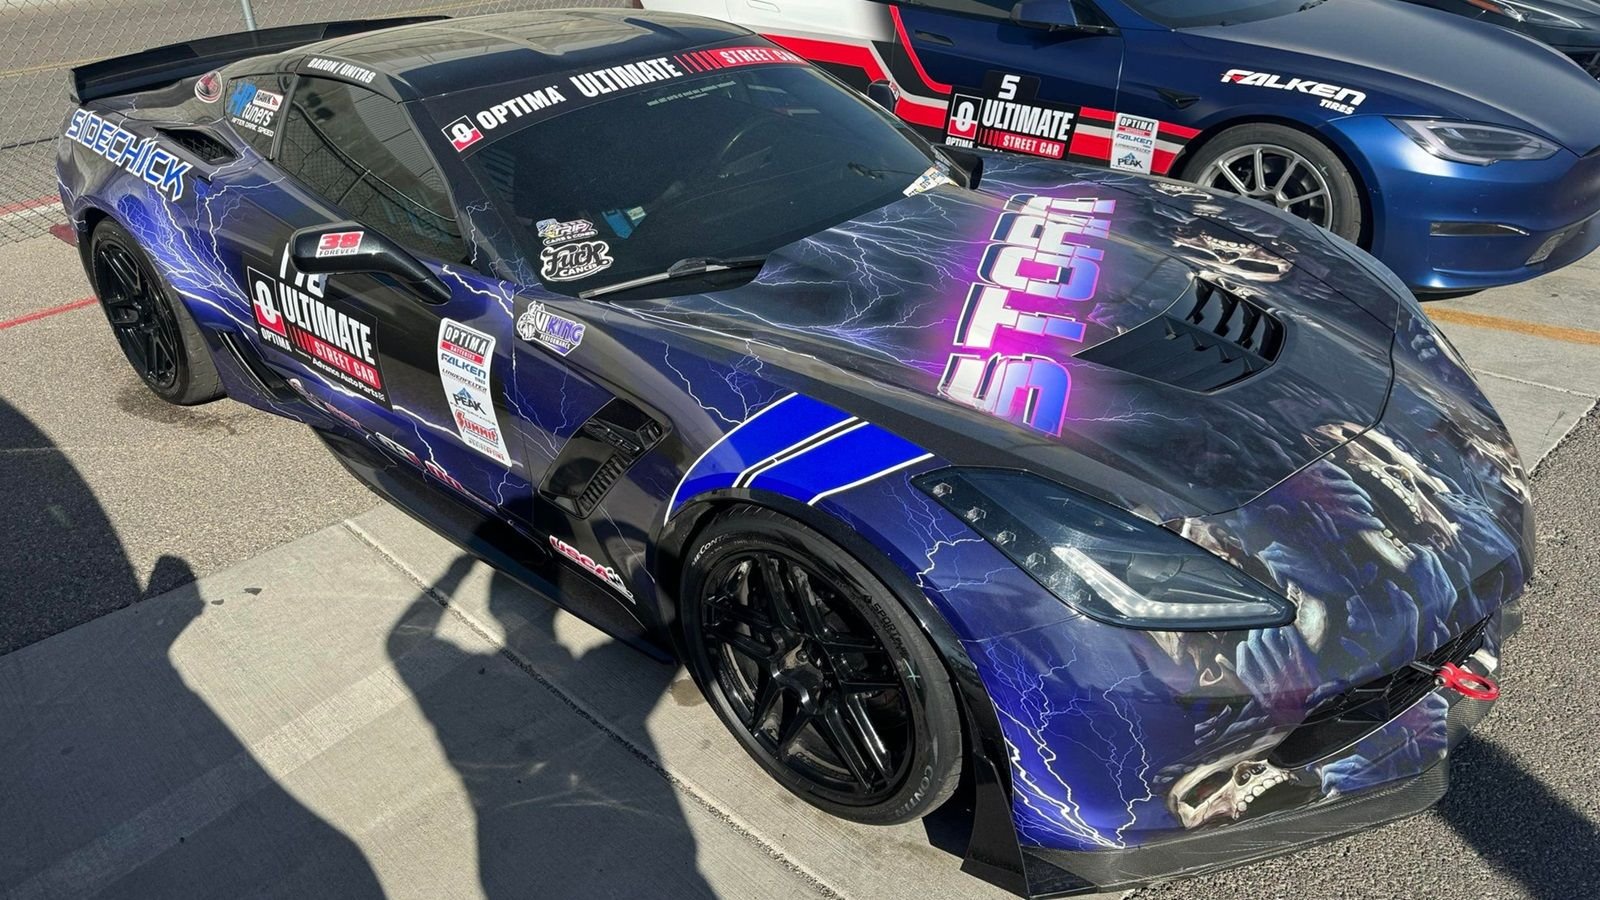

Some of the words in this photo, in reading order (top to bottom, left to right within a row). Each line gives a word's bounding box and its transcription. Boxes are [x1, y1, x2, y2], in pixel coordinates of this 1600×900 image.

[476, 87, 567, 130] OPTIMA
[569, 57, 684, 98] ULTIMATE
[719, 48, 775, 64] STREET
[997, 74, 1021, 101] 5
[1220, 69, 1367, 107] FALKEN
[242, 102, 274, 127] tuners
[981, 99, 1075, 141] ULTIMATE
[1319, 99, 1355, 115] TIRES
[1120, 117, 1153, 131] OPTIMA
[65, 107, 193, 202] SIDECHICK
[945, 136, 974, 149] OPTIMA
[1002, 134, 1036, 152] STREET
[1038, 142, 1060, 157] CAR
[319, 232, 361, 250] 38
[558, 263, 598, 277] CANCER
[279, 281, 376, 366] ULTIMATE
[535, 311, 586, 346] VIKING
[260, 327, 293, 352] OPTIMA
[445, 326, 487, 355] OPTIMA
[313, 340, 352, 372] STREET
[352, 361, 377, 386] CAR
[441, 352, 487, 380] FALKEN
[452, 392, 487, 416] PEAK
